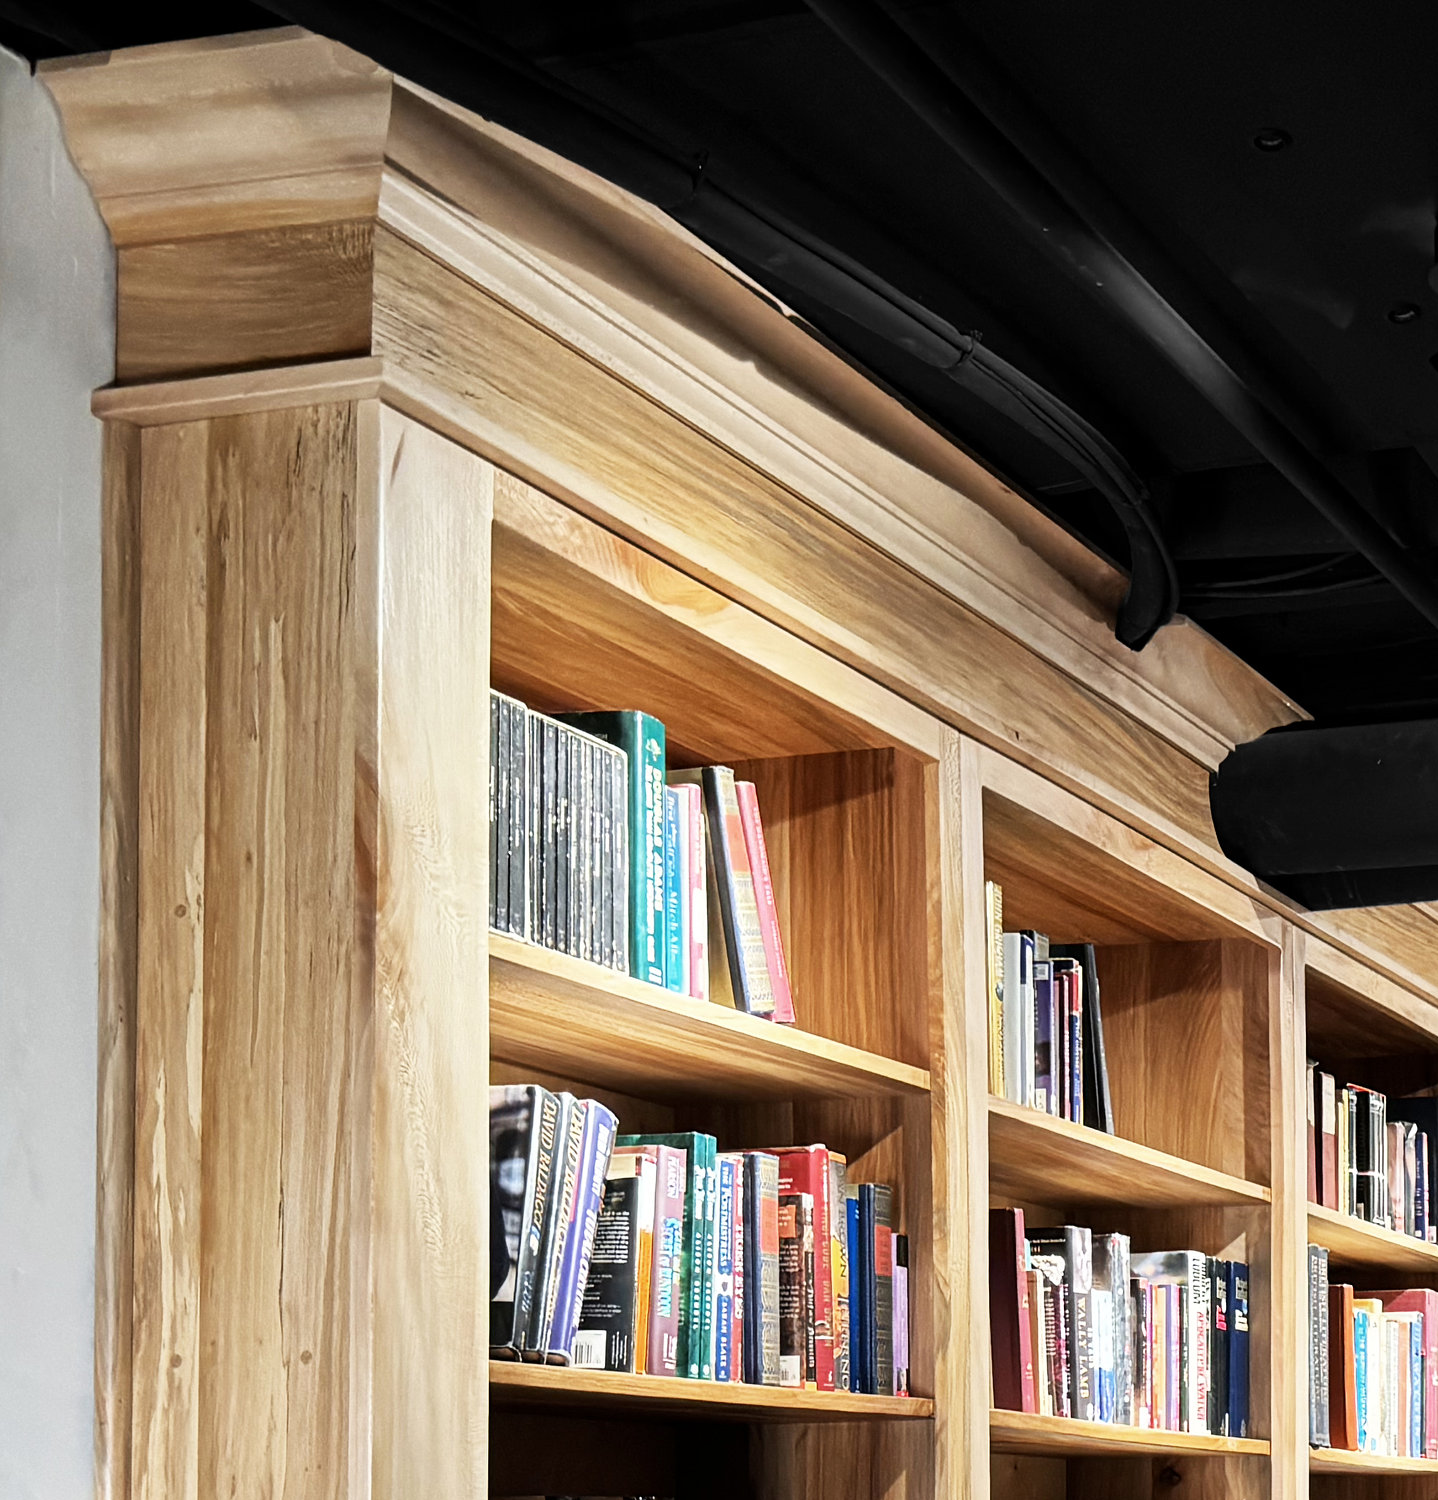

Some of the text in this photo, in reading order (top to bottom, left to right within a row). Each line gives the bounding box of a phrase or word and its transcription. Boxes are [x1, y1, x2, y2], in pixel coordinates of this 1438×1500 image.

[653, 768, 664, 911] DOUGLAS ADAMS
[994, 887, 1003, 978] JOHN GRISHAM
[533, 1100, 557, 1227] DAVID BALDACCI
[557, 1105, 586, 1258] DAVID BALDACCI
[720, 1187, 731, 1268] POSTMISTRESS
[734, 1276, 744, 1319] EYES
[1192, 1258, 1201, 1305] LUDLUM
[720, 1336, 728, 1367] BLAKE
[1076, 1296, 1090, 1399] WALLY LAMB
[1196, 1311, 1206, 1379] APOCALYPSE
[1196, 1382, 1206, 1421] WATCH
